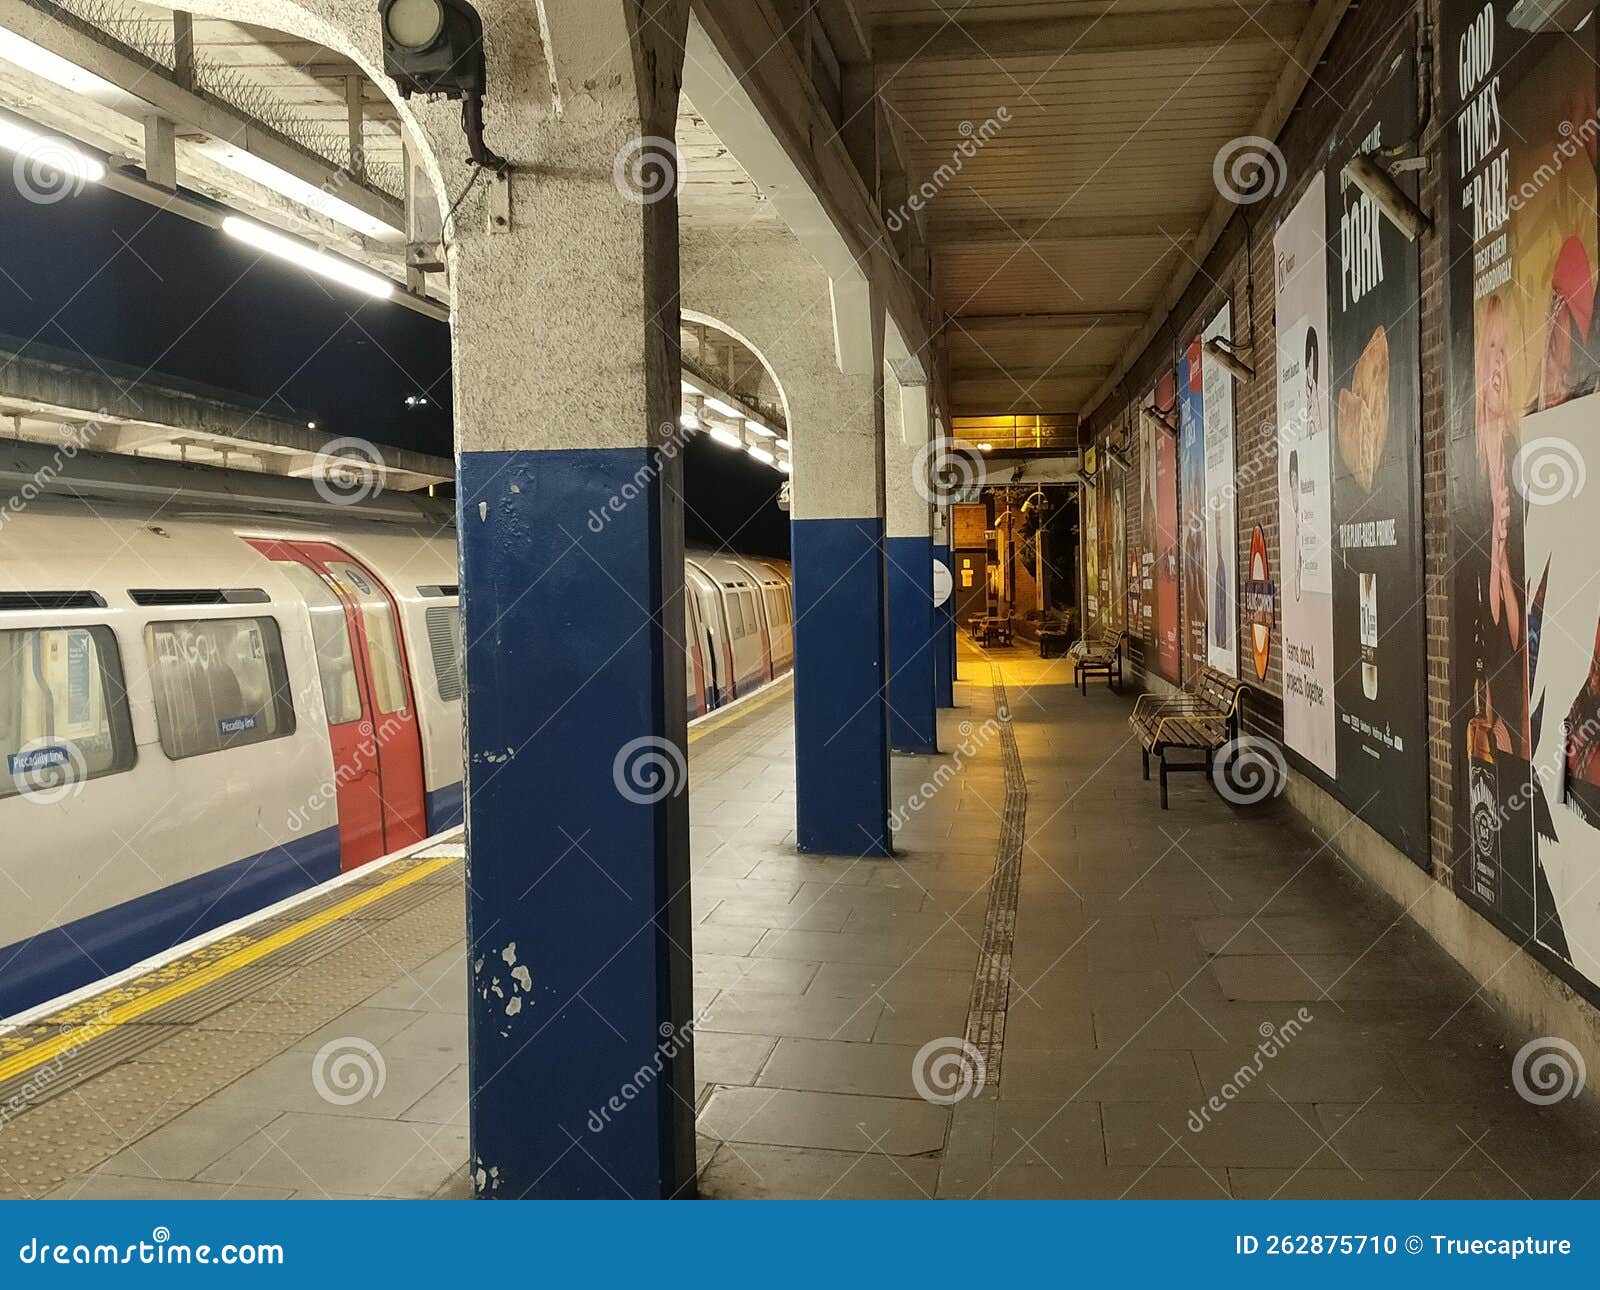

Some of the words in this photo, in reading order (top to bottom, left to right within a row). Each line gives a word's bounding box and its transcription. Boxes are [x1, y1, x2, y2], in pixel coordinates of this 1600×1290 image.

[1459, 2, 1494, 100] GOOD
[1458, 76, 1500, 179] TIMES
[1462, 182, 1473, 209] ARE
[1473, 148, 1510, 244] RARE
[1341, 192, 1384, 312] PORK
